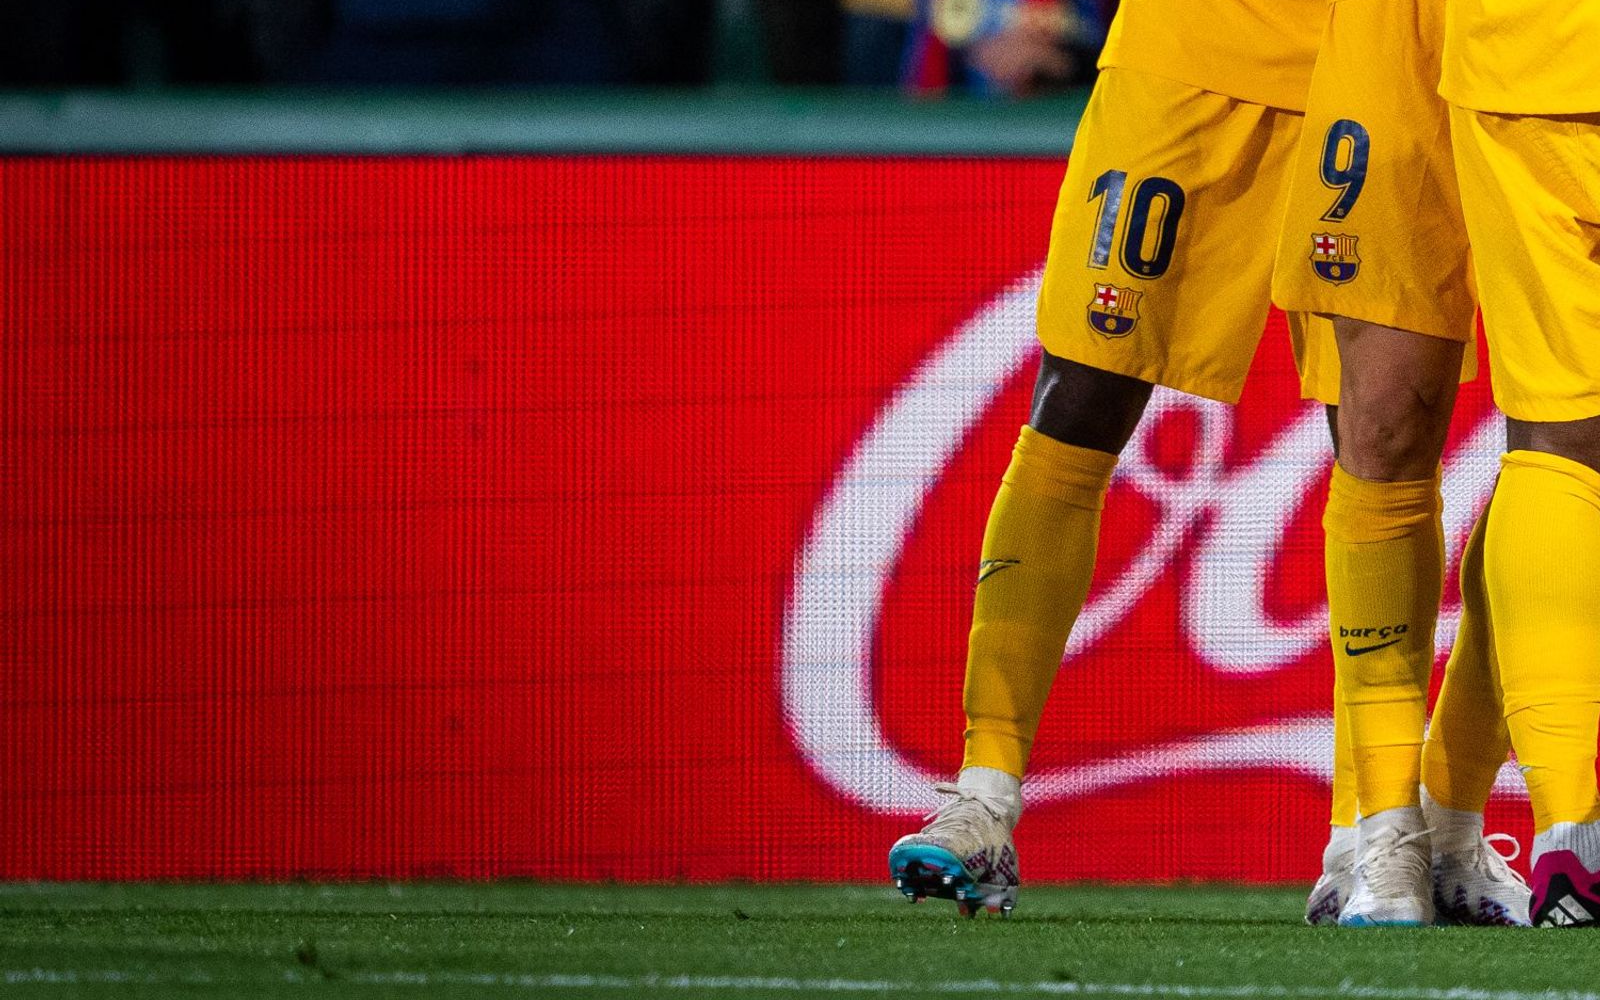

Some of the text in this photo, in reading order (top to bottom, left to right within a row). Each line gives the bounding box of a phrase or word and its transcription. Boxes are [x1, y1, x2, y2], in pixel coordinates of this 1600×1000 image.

[1319, 119, 1370, 223] 9
[1087, 169, 1186, 280] 10
[1340, 625, 1409, 639] barça
